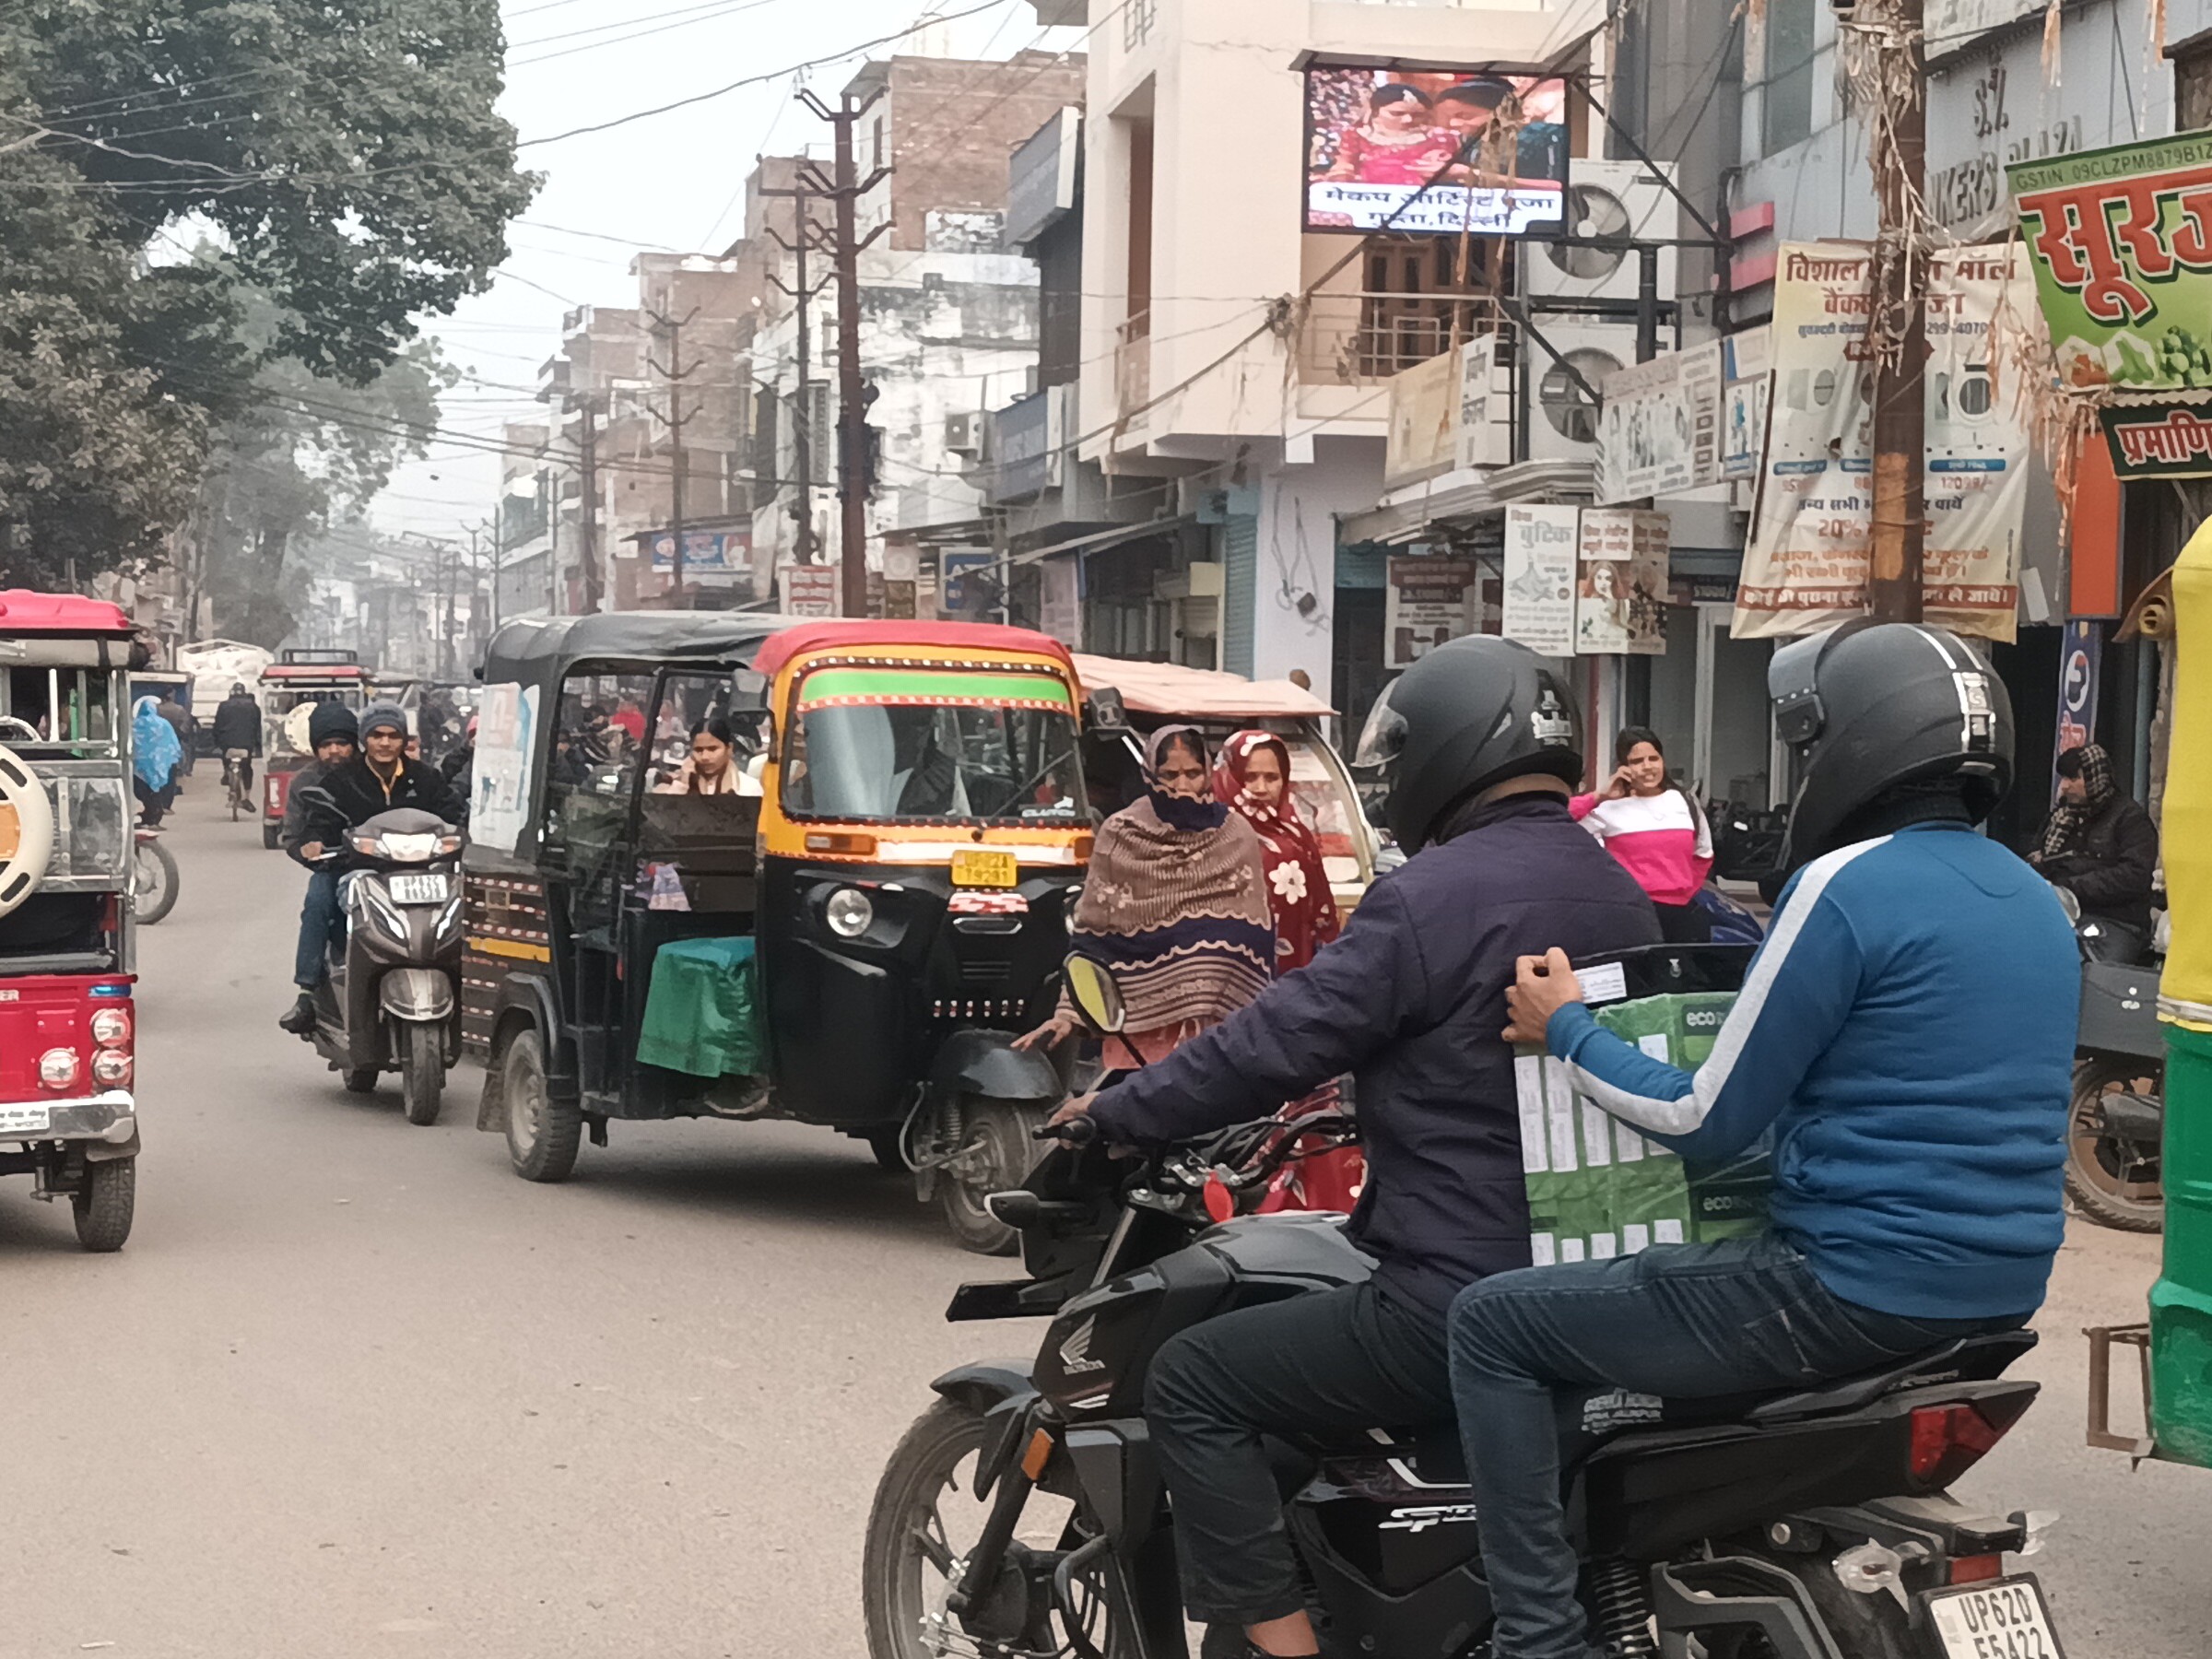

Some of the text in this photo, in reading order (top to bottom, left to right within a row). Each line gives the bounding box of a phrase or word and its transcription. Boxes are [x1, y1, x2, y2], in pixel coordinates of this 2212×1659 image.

[2016, 169, 2064, 190] GSTIN
[1785, 251, 1860, 282] विशाल
[1818, 519, 1863, 538] 20%
